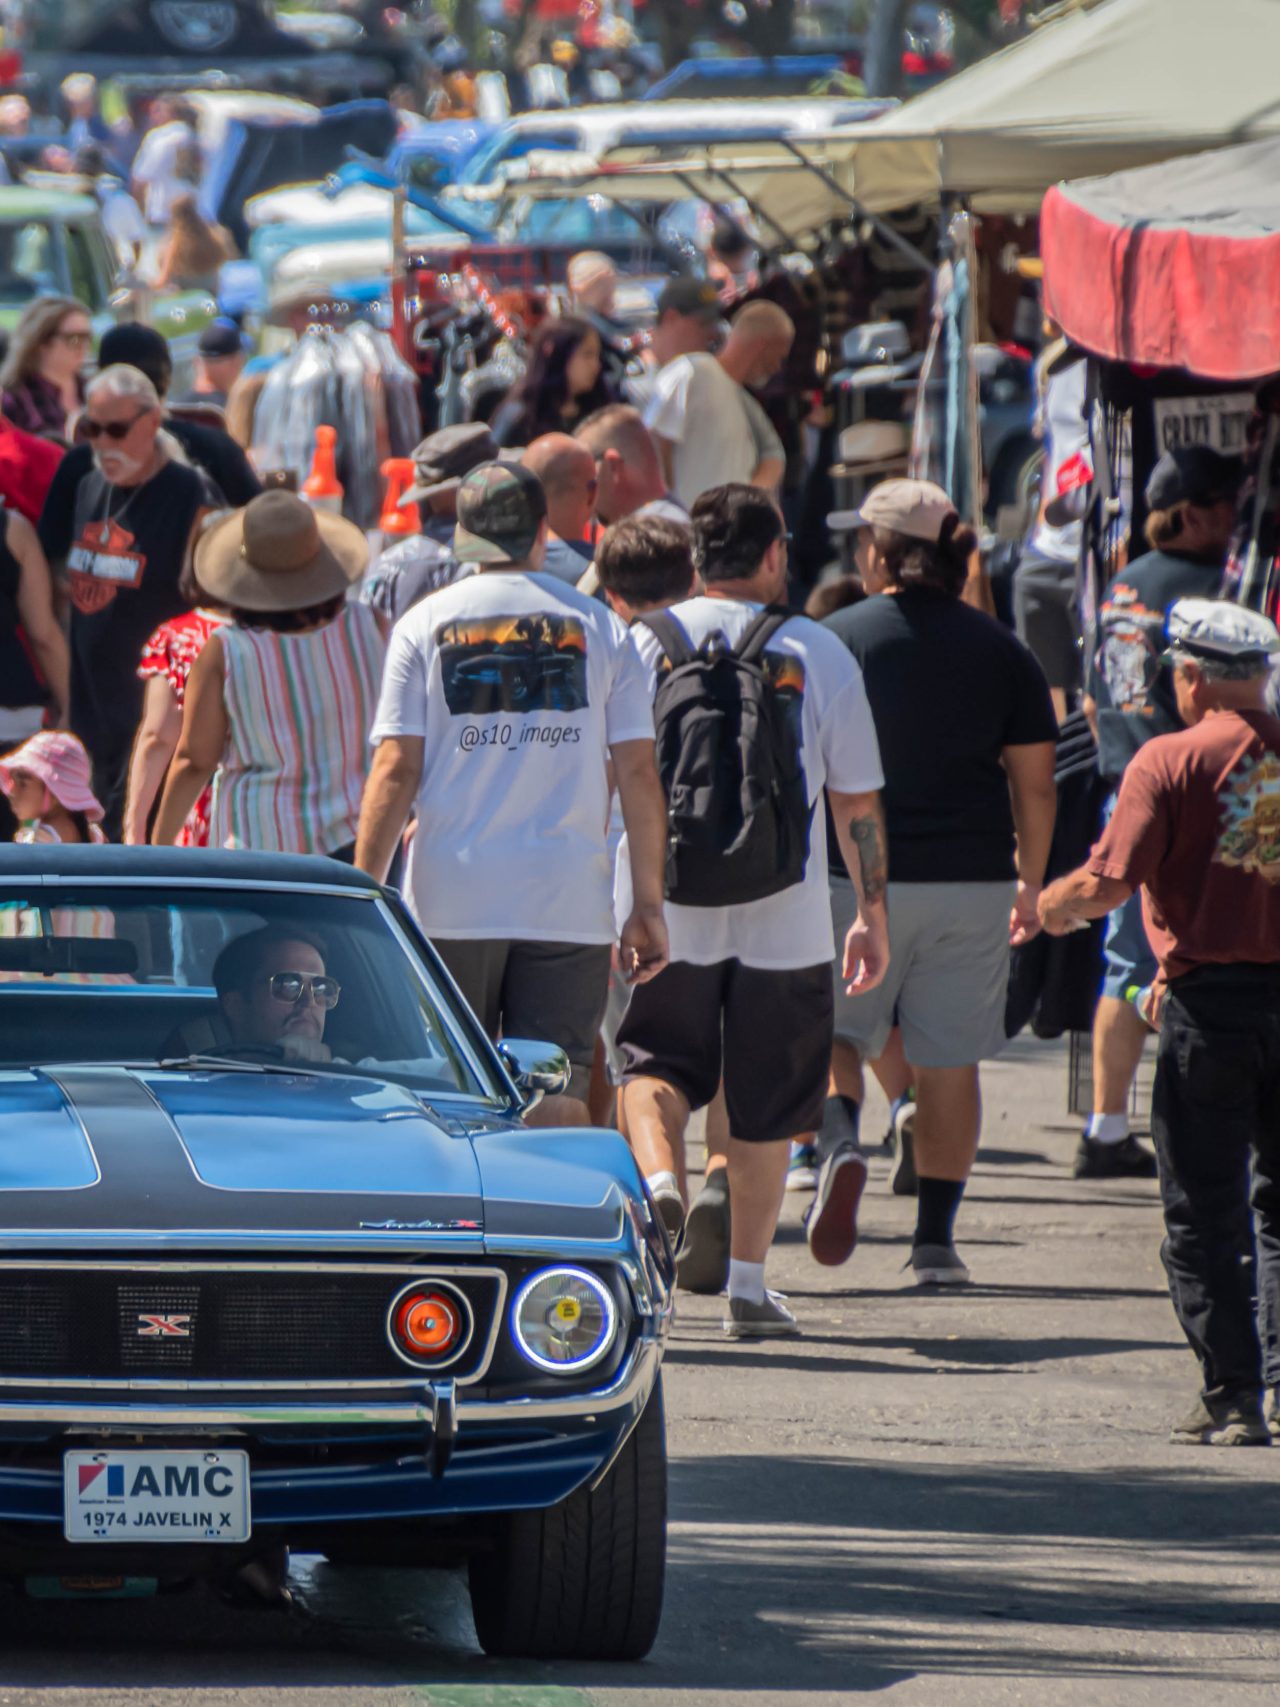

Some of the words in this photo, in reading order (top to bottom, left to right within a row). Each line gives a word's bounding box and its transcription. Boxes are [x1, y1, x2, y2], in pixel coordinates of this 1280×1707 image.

[460, 722, 582, 752] @s10_images
[138, 1314, 191, 1336] X
[129, 1464, 235, 1498] AMC
[83, 1512, 127, 1527] 1974
[133, 1512, 213, 1528] JAVELIN
[219, 1512, 232, 1527] X
